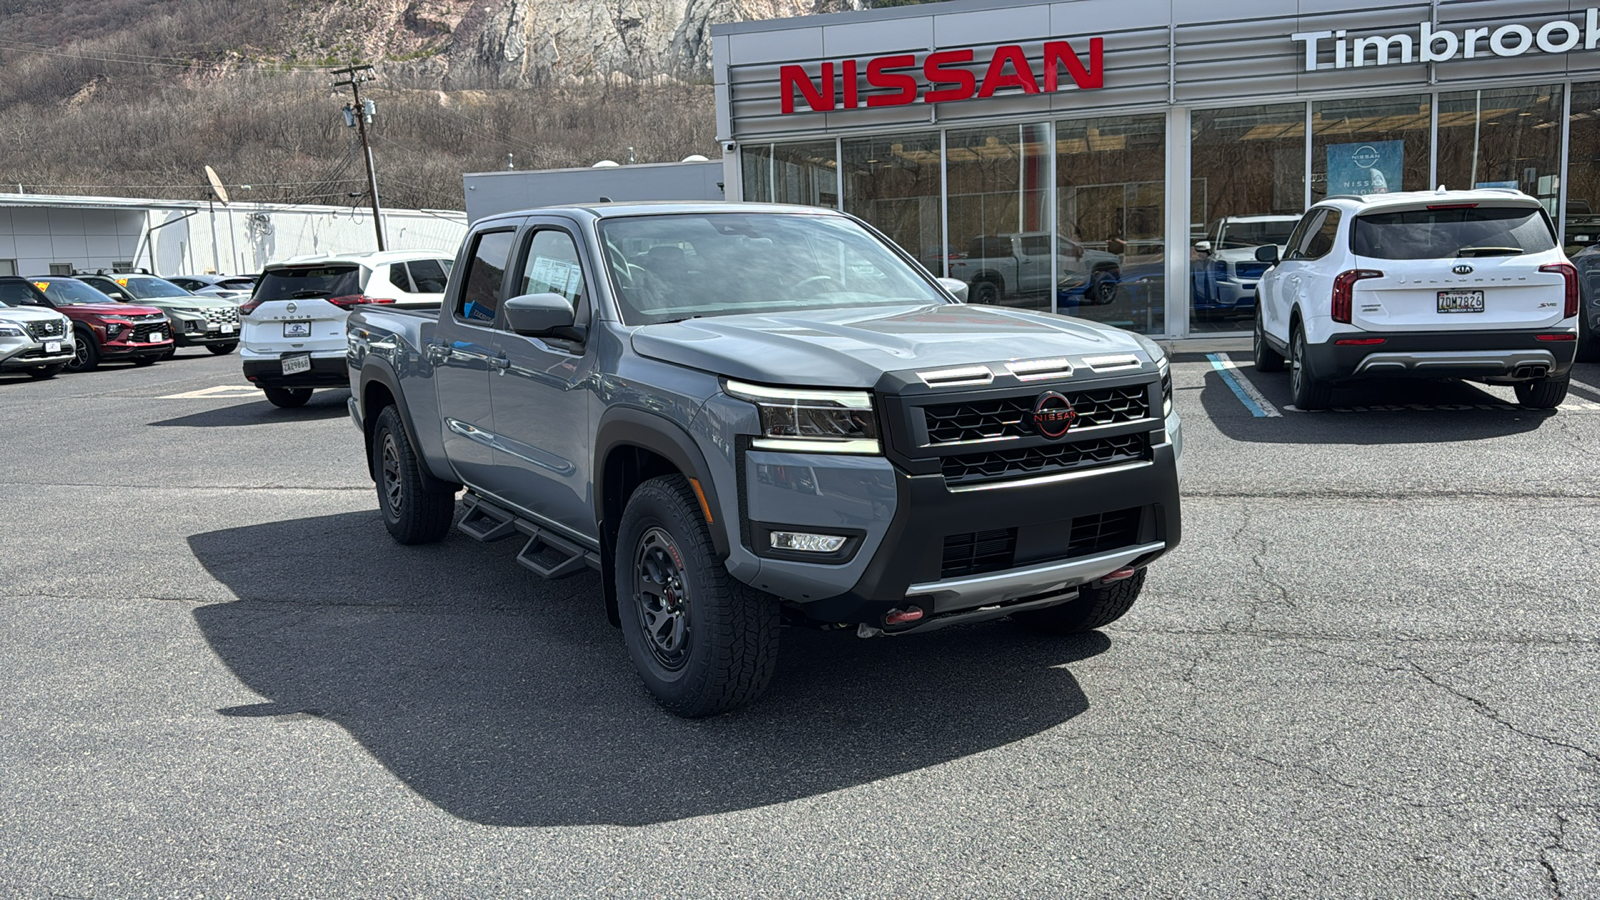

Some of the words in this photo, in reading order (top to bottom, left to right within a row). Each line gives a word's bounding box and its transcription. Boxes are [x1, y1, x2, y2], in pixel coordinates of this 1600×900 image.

[780, 37, 1104, 114] NISSAN
[1439, 296, 1482, 308] 7DM7826
[1034, 411, 1076, 421] NISSAN
